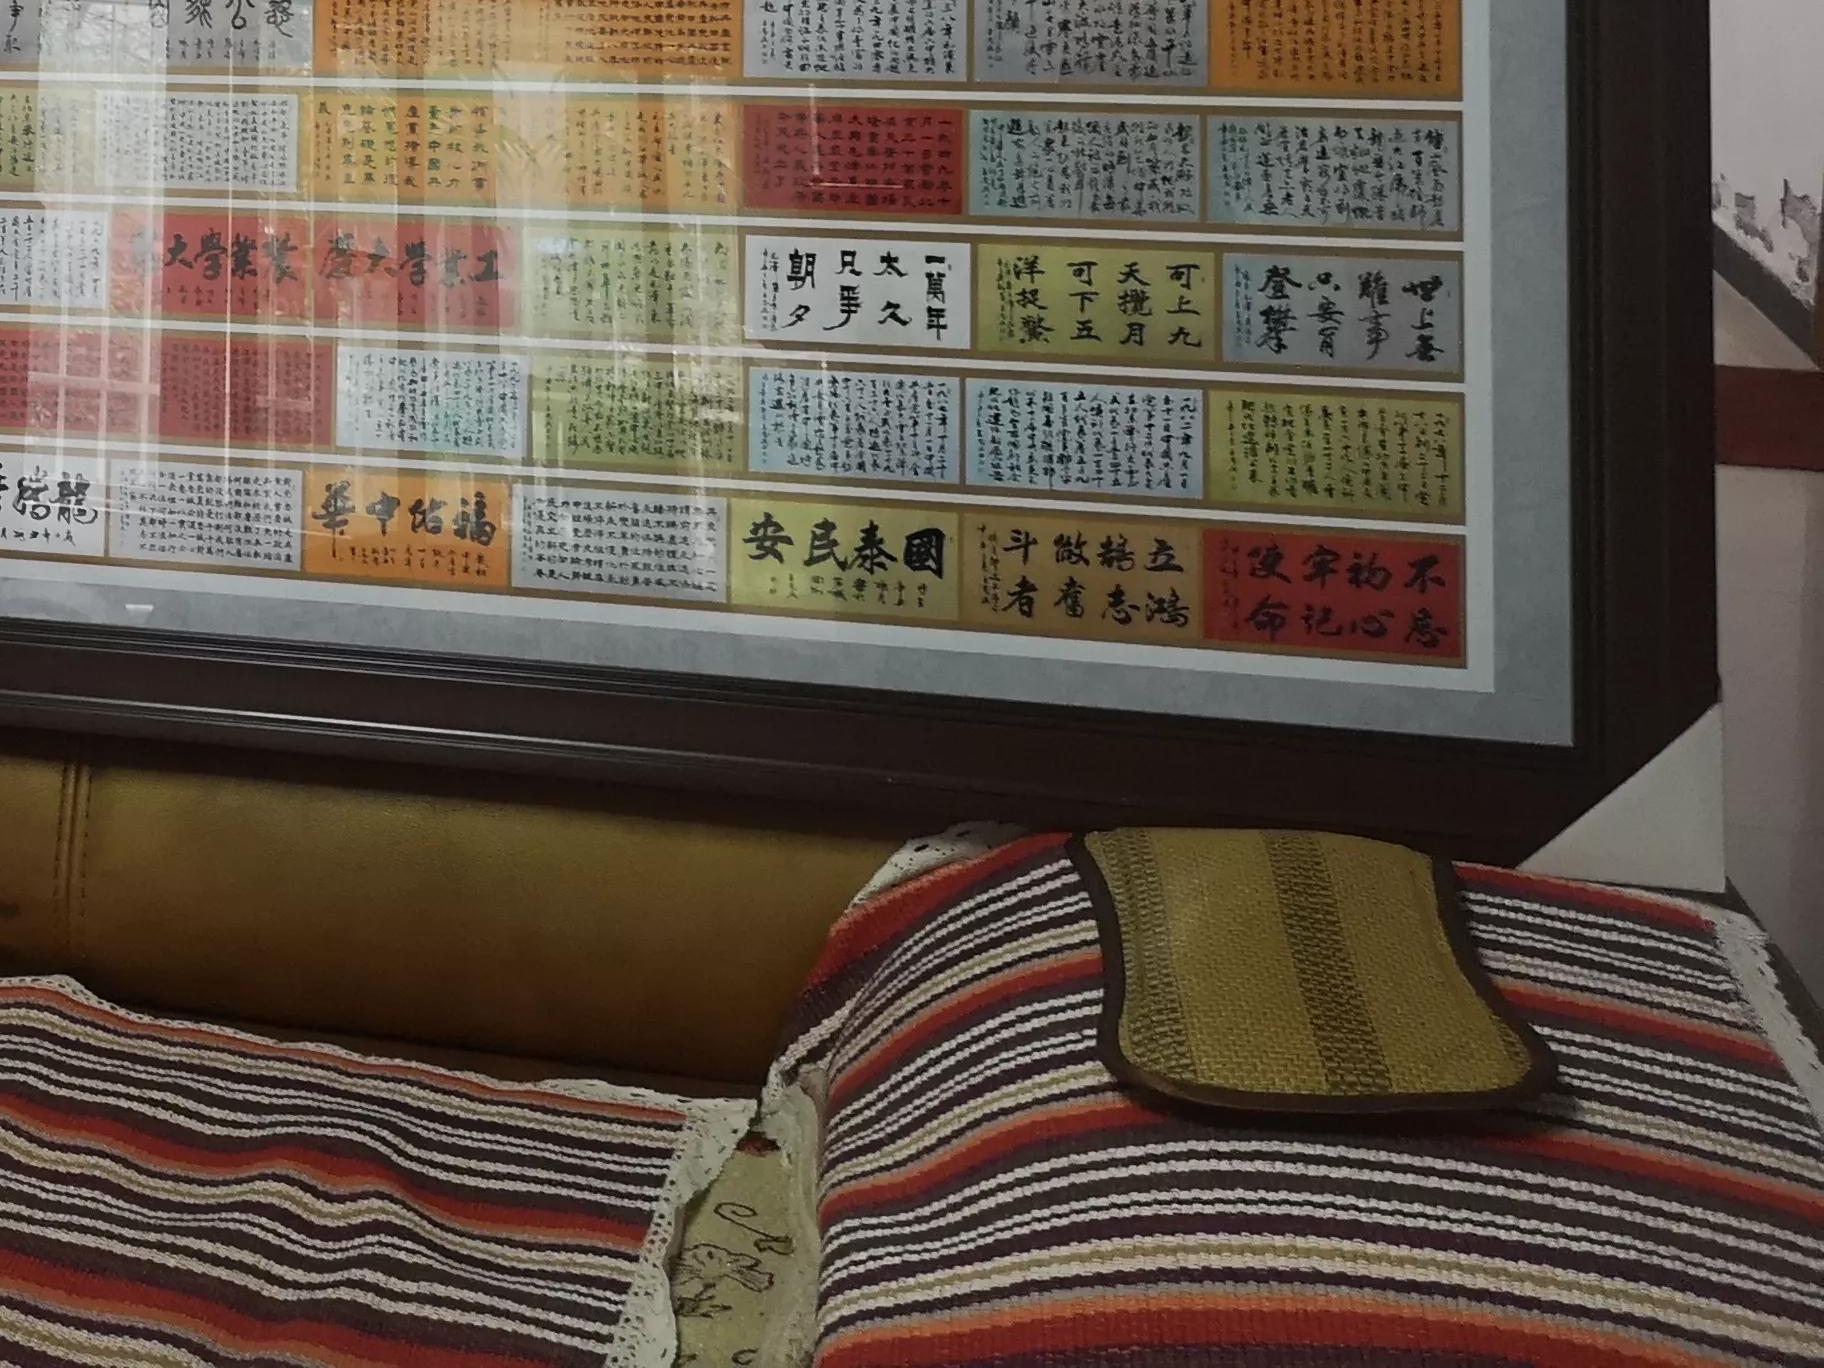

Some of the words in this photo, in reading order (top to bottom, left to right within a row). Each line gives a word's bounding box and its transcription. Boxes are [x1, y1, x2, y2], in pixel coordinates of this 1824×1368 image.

[781, 248, 817, 329] 朝夕
[873, 251, 912, 327] 太久
[1067, 260, 1103, 342] 可下五
[1166, 263, 1203, 348] 可上九
[743, 512, 947, 579] 國泰民安
